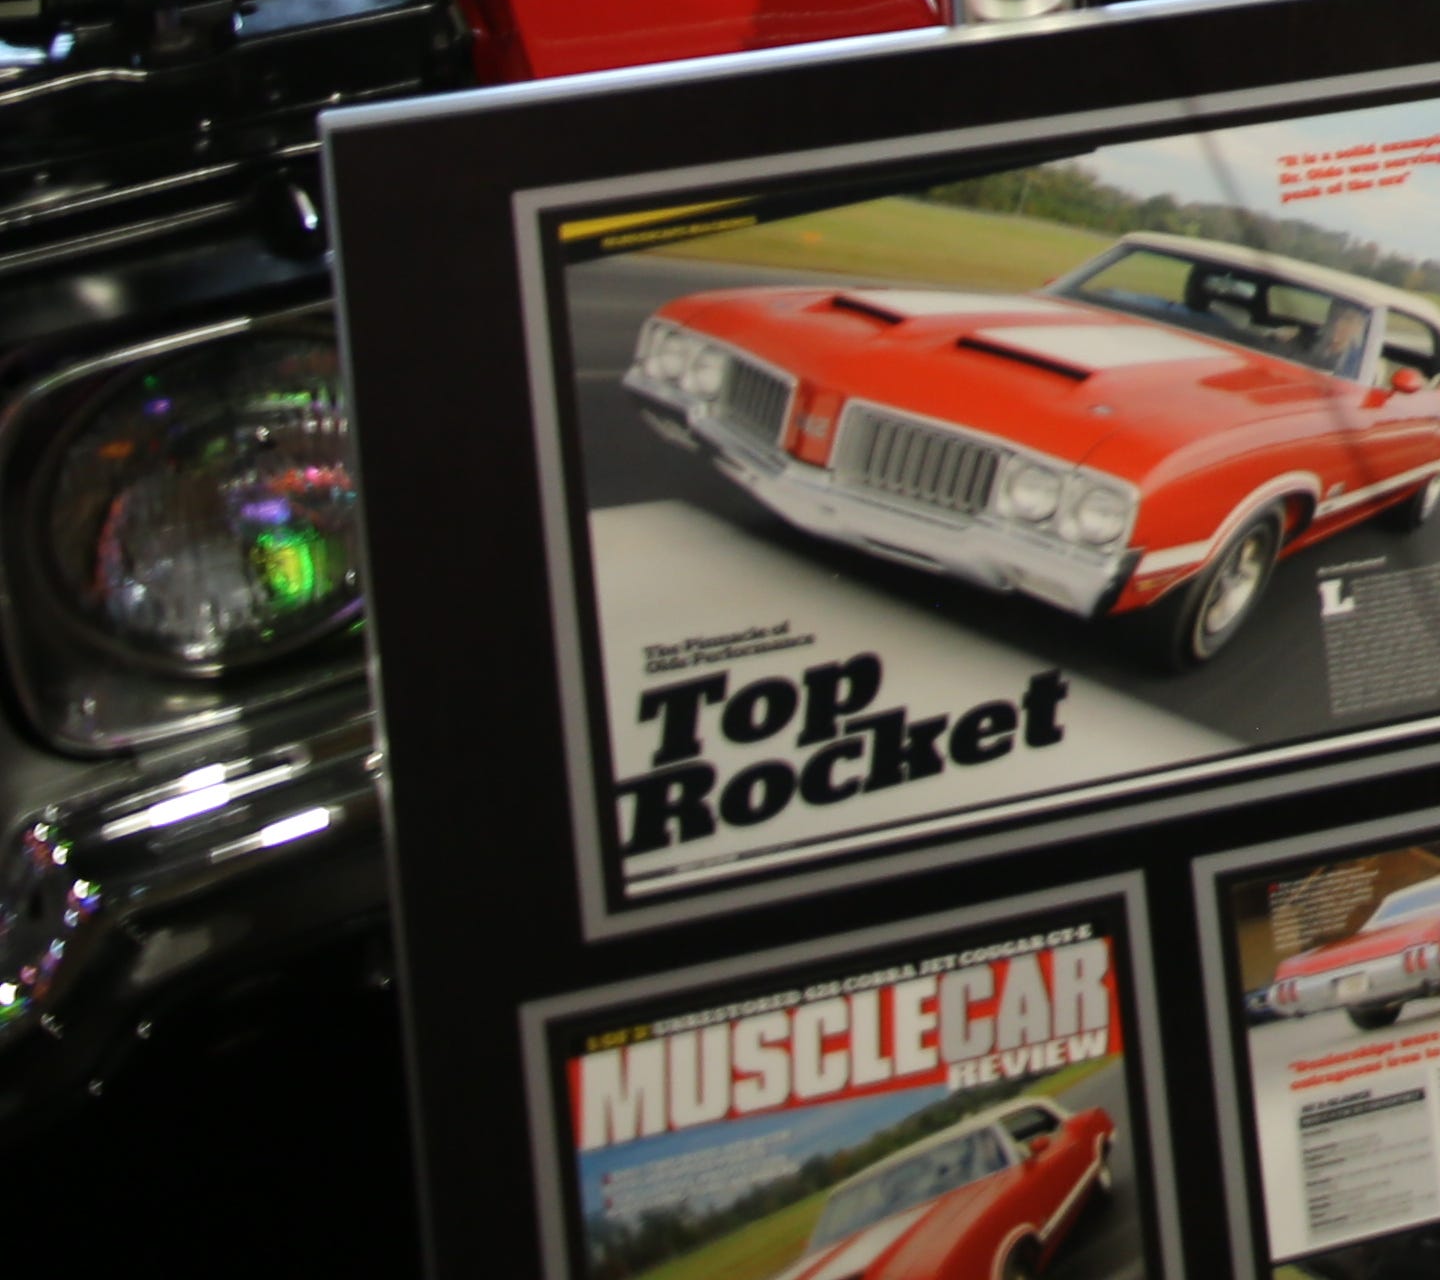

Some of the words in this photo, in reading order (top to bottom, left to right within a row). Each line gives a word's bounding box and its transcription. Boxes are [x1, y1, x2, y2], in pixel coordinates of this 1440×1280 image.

[617, 667, 1070, 856] Rocket
[637, 651, 884, 767] Top
[581, 939, 1110, 1146] MUSCLECAR
[948, 1029, 1111, 1093] REVIEW
